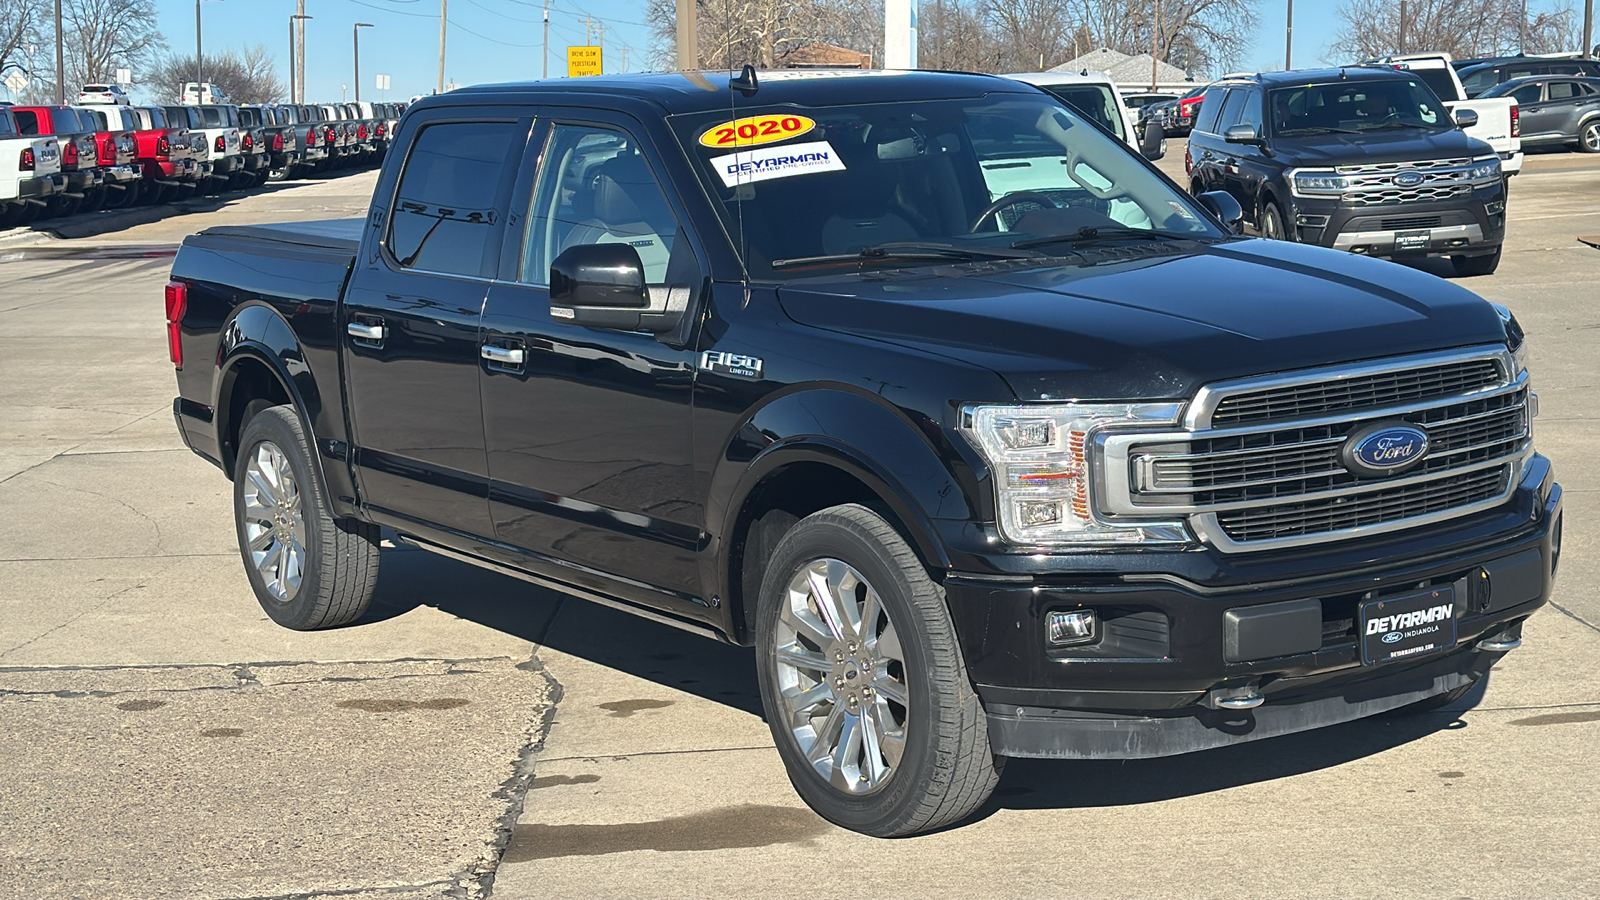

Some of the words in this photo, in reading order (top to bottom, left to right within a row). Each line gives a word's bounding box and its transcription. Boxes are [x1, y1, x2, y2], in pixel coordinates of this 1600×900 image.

[715, 117, 801, 145] 2020
[727, 151, 829, 174] DEYARMAN
[738, 166, 781, 177] CERTIFIED
[729, 367, 754, 376] LIMITED
[1373, 436, 1414, 461] Ford
[1366, 603, 1453, 636] DEYARMAN
[1404, 625, 1440, 638] INDIANOLA
